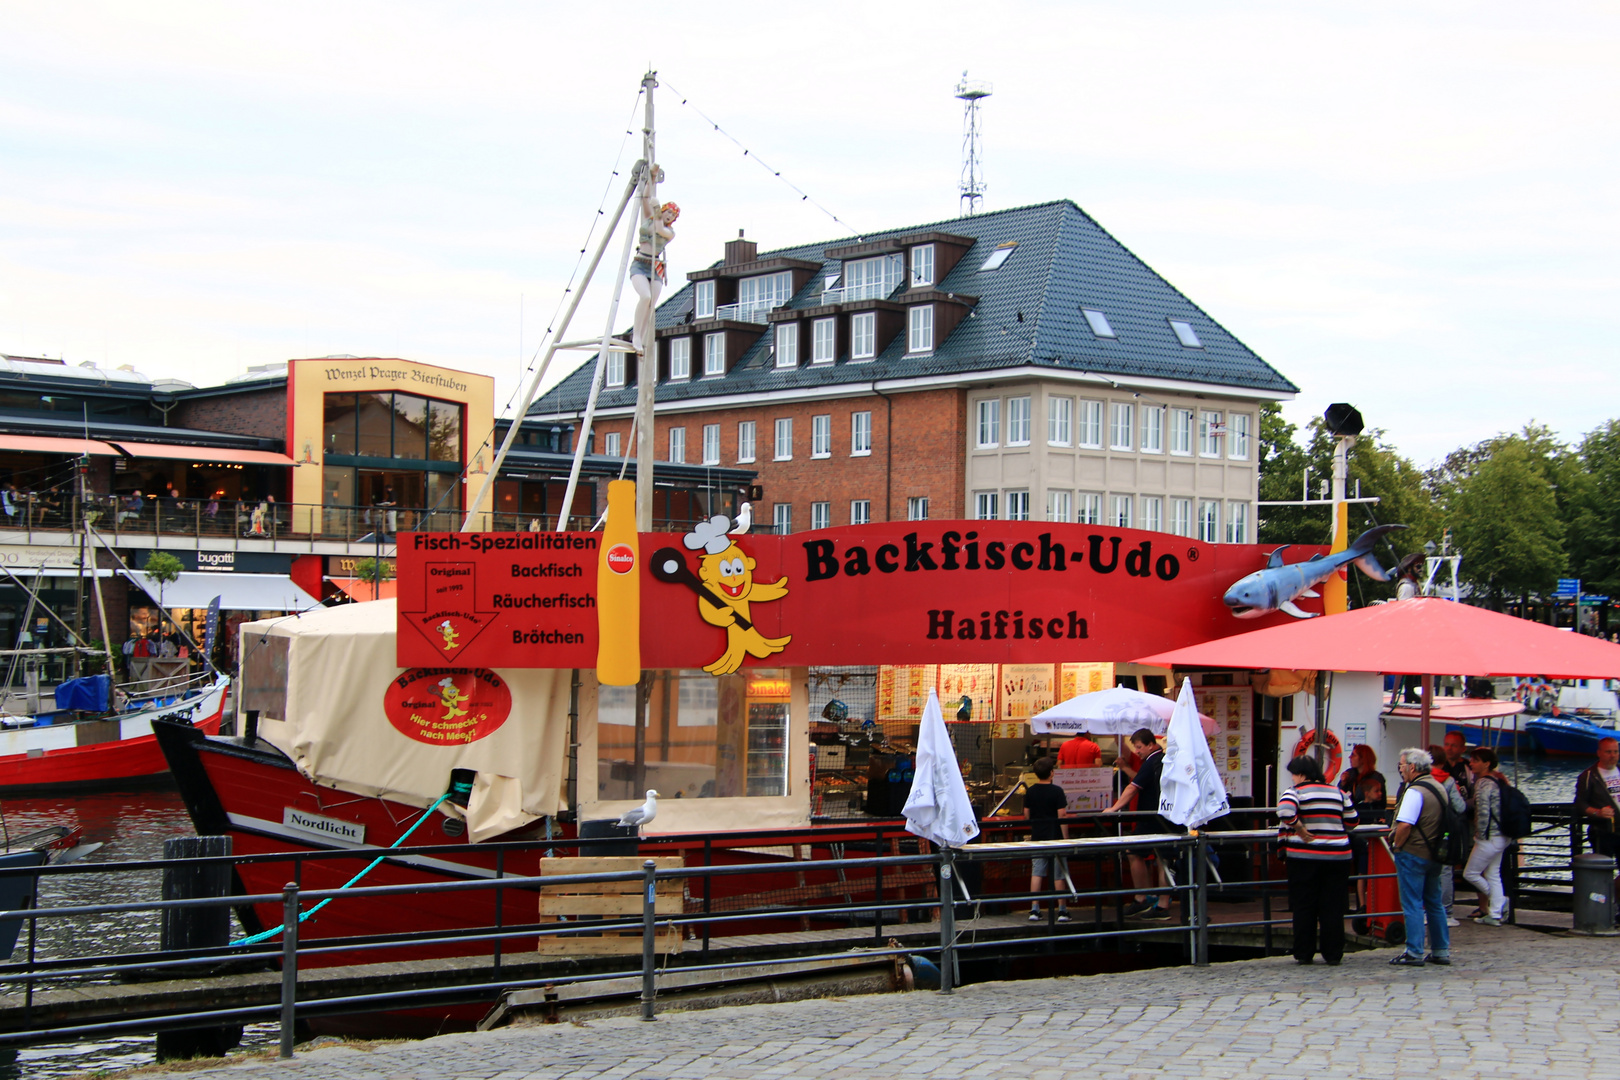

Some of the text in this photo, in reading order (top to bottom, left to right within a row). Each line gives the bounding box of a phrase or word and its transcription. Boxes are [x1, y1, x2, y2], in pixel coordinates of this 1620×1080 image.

[325, 366, 367, 381] Wenzel
[370, 366, 408, 381] Prager
[414, 534, 597, 553] Fisch-Spezialitäten
[197, 551, 234, 566] bugatti
[609, 553, 633, 562] Sinalco
[802, 530, 1180, 582] Backfisch-Udo
[430, 568, 471, 576] Original
[511, 563, 582, 577] Backfisch
[436, 586, 448, 594] seit
[493, 593, 596, 608] Räucherfisch
[926, 610, 1089, 640] Haifisch
[512, 630, 584, 644] Brötchen
[748, 681, 791, 695] Sinalco
[410, 713, 431, 727] Hier
[420, 729, 444, 740] nach
[291, 813, 357, 838] Nordlicht
